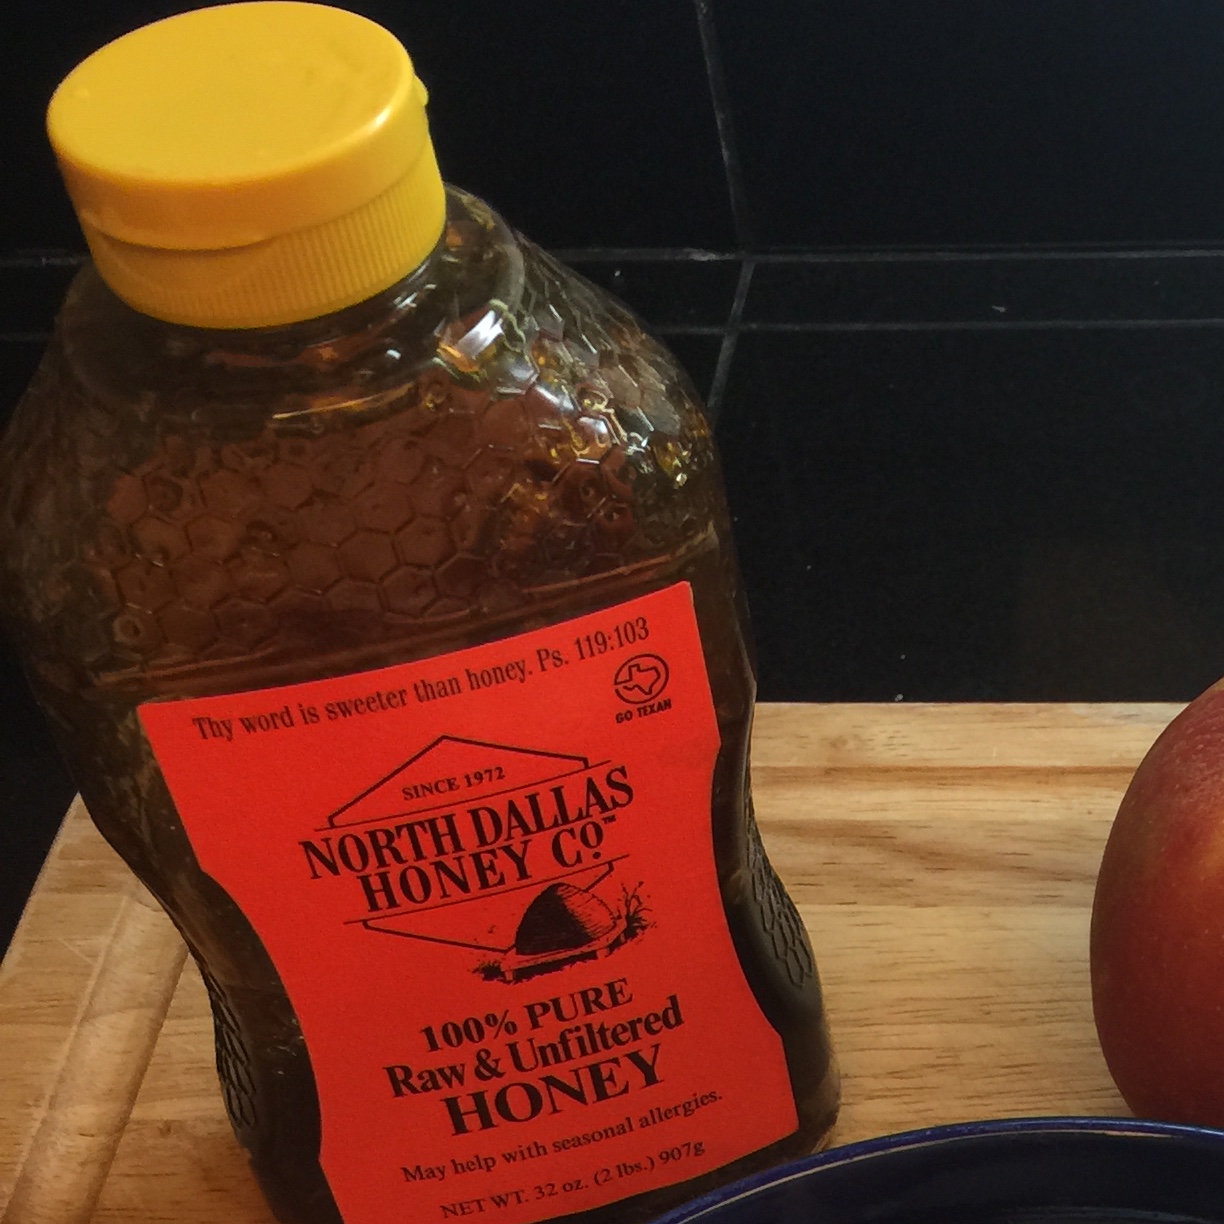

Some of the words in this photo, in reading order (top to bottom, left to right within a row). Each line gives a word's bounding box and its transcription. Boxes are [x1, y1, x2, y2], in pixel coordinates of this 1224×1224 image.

[192, 716, 234, 742] Thy
[240, 705, 295, 734] word
[298, 704, 320, 726] is
[325, 687, 408, 721] sweeter
[413, 674, 463, 704] than
[465, 659, 534, 692] honey.
[535, 648, 570, 672] Ps.
[574, 616, 650, 661] 119:103
[615, 710, 634, 724] GO
[637, 698, 672, 718] TEXAN
[299, 812, 467, 880] NORTH
[467, 765, 634, 849] DALLAS
[401, 776, 461, 801] SINCE
[464, 766, 506, 789] 1972
[356, 839, 533, 913] HONEY
[382, 1062, 466, 1098] Raw
[473, 1048, 506, 1082] &
[505, 994, 685, 1074] Unfiltered
[419, 1009, 518, 1053] 100%
[524, 977, 634, 1031] PURE
[440, 1043, 665, 1137] HONEY
[400, 1162, 446, 1183] May
[450, 1154, 498, 1175] help
[502, 1140, 549, 1165] with
[552, 1116, 634, 1153] seasonal
[638, 1089, 724, 1129] allergies.
[440, 1197, 487, 1220] NET
[489, 1189, 530, 1210] WT.
[535, 1182, 558, 1201] 32
[561, 1177, 590, 1194] oz.
[593, 1168, 613, 1188] (2
[616, 1155, 656, 1180] lbs.)
[658, 1139, 706, 1165] 907g
